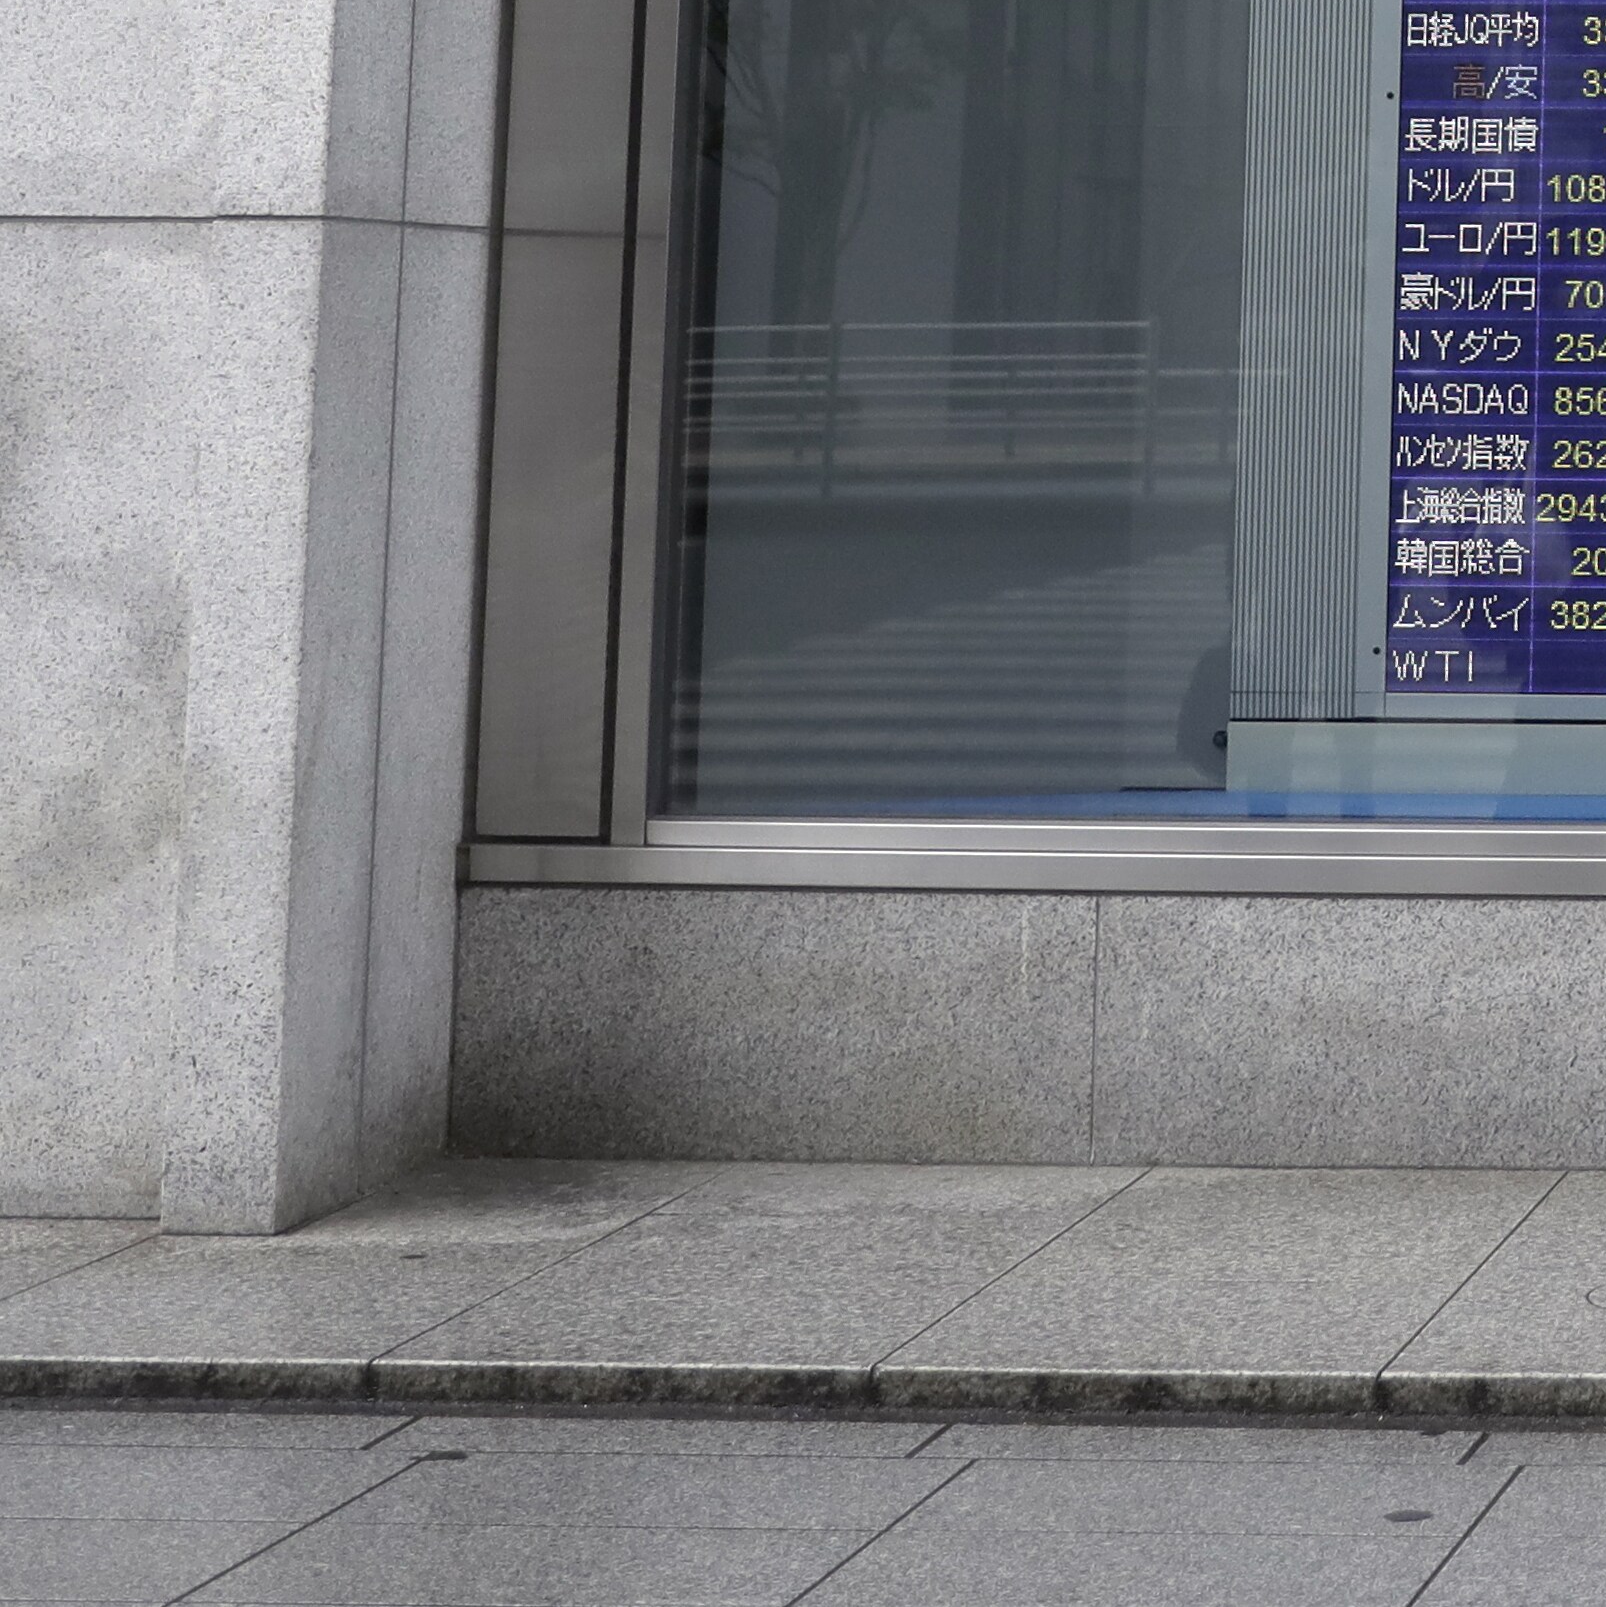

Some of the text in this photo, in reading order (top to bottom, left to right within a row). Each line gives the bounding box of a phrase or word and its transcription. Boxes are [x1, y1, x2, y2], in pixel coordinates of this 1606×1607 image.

[1453, 63, 1538, 100] 高/安
[1404, 115, 1539, 153] 長期国債
[1408, 168, 1515, 203] ドル/円
[1401, 221, 1537, 256] ユーロ/円
[1397, 382, 1529, 415] NASDAQ
[1394, 537, 1530, 578] 韓国総合
[1392, 593, 1529, 632] ムンバイ
